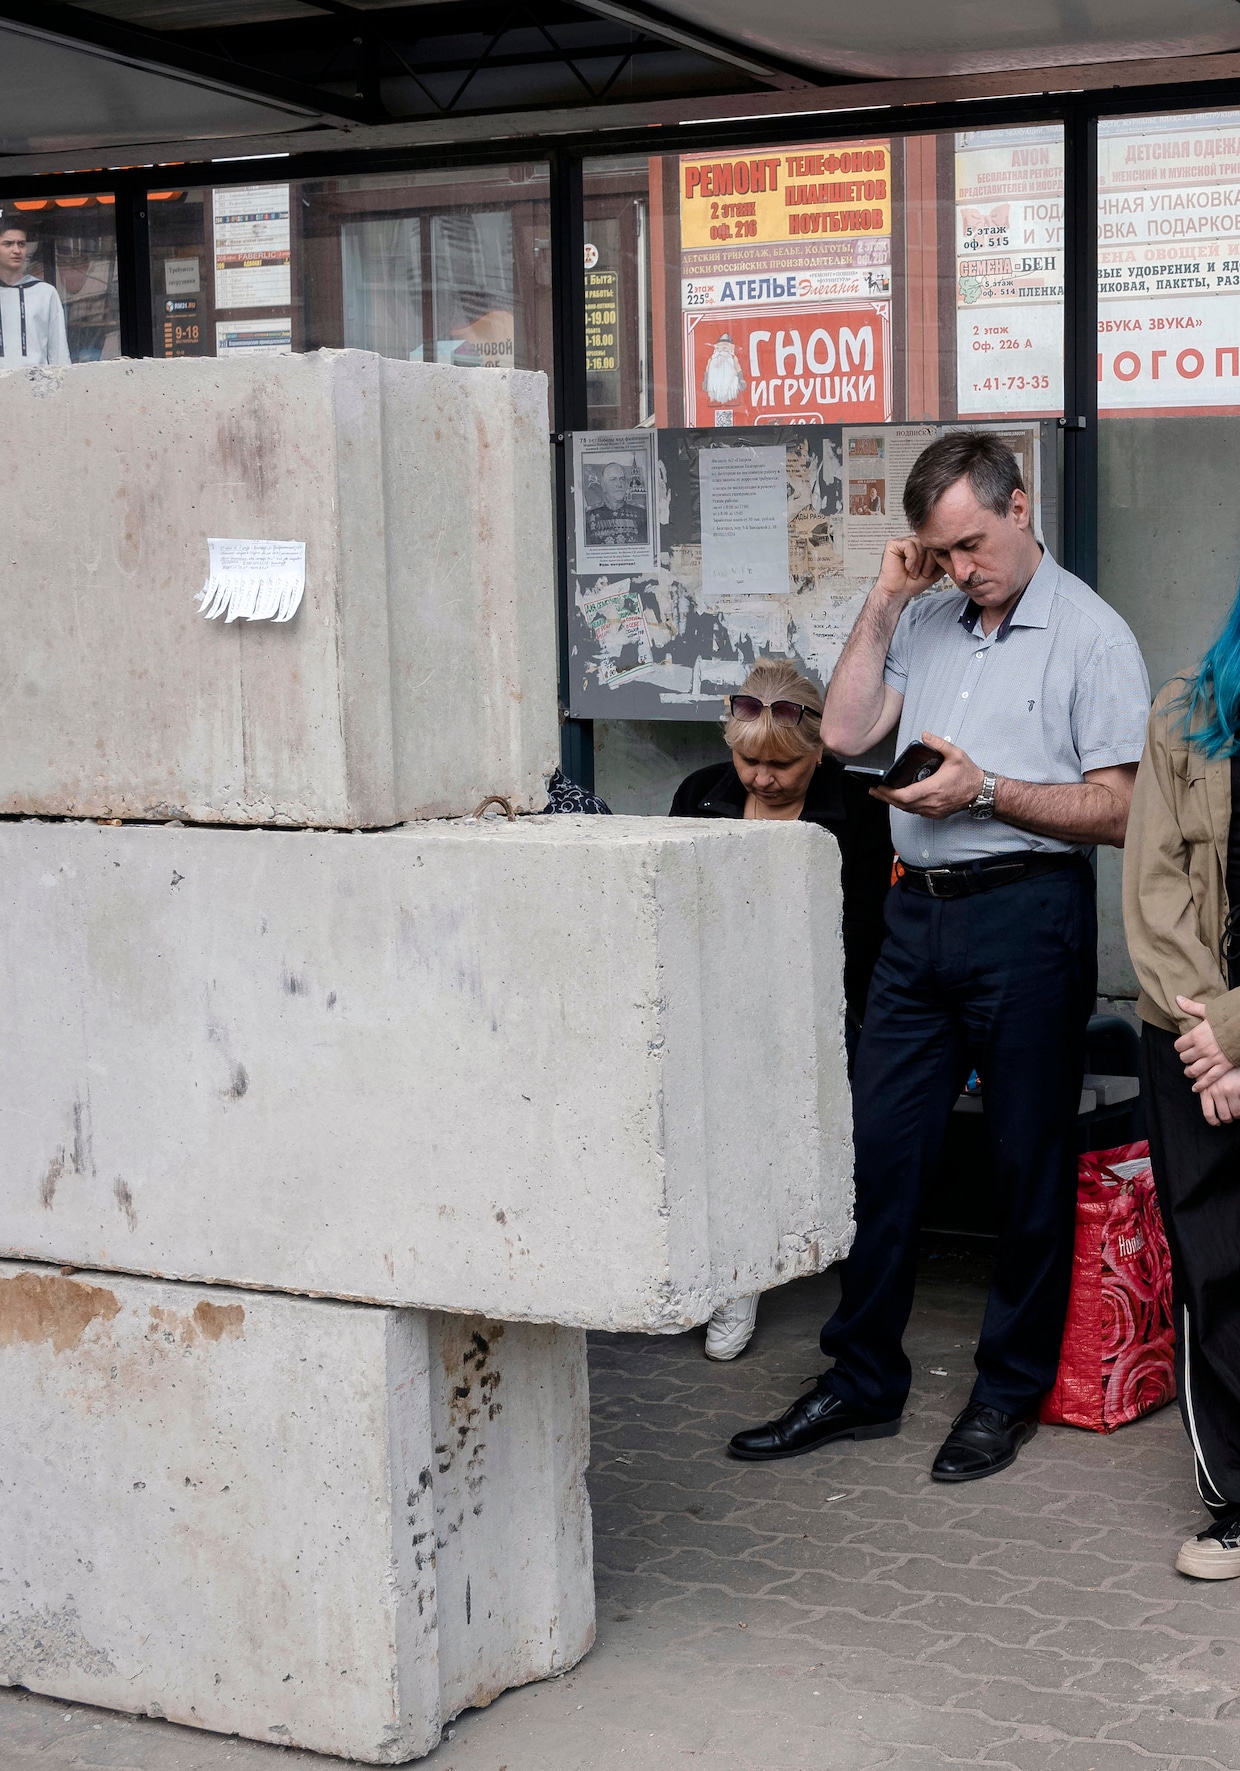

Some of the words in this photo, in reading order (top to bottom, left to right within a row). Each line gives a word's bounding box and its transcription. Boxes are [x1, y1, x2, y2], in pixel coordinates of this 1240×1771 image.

[1012, 148, 1049, 167] AVON
[1125, 140, 1190, 164] ДЕТСКАЯ
[785, 150, 885, 177] ТЕЛЕФОНОВ
[1112, 167, 1157, 182] ЖЕНСКИЙ
[1160, 168, 1166, 179] И
[1168, 162, 1217, 179] МУЖСКОЙ
[685, 158, 781, 199] РЕМОНТ
[977, 169, 1028, 183] БЕСПЛАТНАЯ
[785, 179, 887, 206] ПЛАНШЕТОВ
[959, 181, 1028, 198] ПРЕДСТАВИТЕЛЕЙ
[710, 202, 719, 219] 2
[721, 201, 756, 218] этаж
[710, 223, 733, 241] оф.
[735, 220, 757, 238] 216
[789, 209, 884, 235] НОУТБУКОВ
[966, 228, 972, 237] 5
[977, 226, 1006, 235] этаж
[1023, 229, 1034, 244] И
[964, 239, 983, 250] оф.
[988, 237, 1009, 247] 515
[238, 251, 277, 260] FABERLIC
[682, 251, 720, 264] ДЕТСКИЙ
[1097, 250, 1136, 264] ЕНА
[1144, 242, 1220, 261] ОВОЩЕЙ
[1227, 243, 1240, 256] И
[683, 266, 711, 275] НОСКИ
[713, 261, 768, 273] РОССИЙСКИХ
[770, 255, 852, 269] ПРОИЗВОДИТЕЛЕЙ
[960, 257, 1012, 277] СЕМЕНА
[1128, 263, 1200, 279] УДОБРЕНИЯ
[1207, 262, 1215, 272] И
[687, 283, 693, 293] 2
[694, 285, 714, 293] этаж
[720, 276, 796, 302] АТЕЛЬЕ
[798, 279, 860, 297] Элегант
[983, 289, 996, 297] оф.
[1097, 281, 1150, 293] ИКОВАЯ,
[1156, 278, 1210, 290] ПАКЕТЫ,
[175, 325, 199, 340] 9-18
[972, 325, 979, 335] 2
[984, 327, 1009, 335] этаж
[1149, 316, 1203, 331] ЗВУКА»
[750, 325, 874, 377] ГНОМ
[972, 340, 994, 353] Оф.
[999, 339, 1019, 350] 226
[751, 375, 875, 407] ИГРУШКИ
